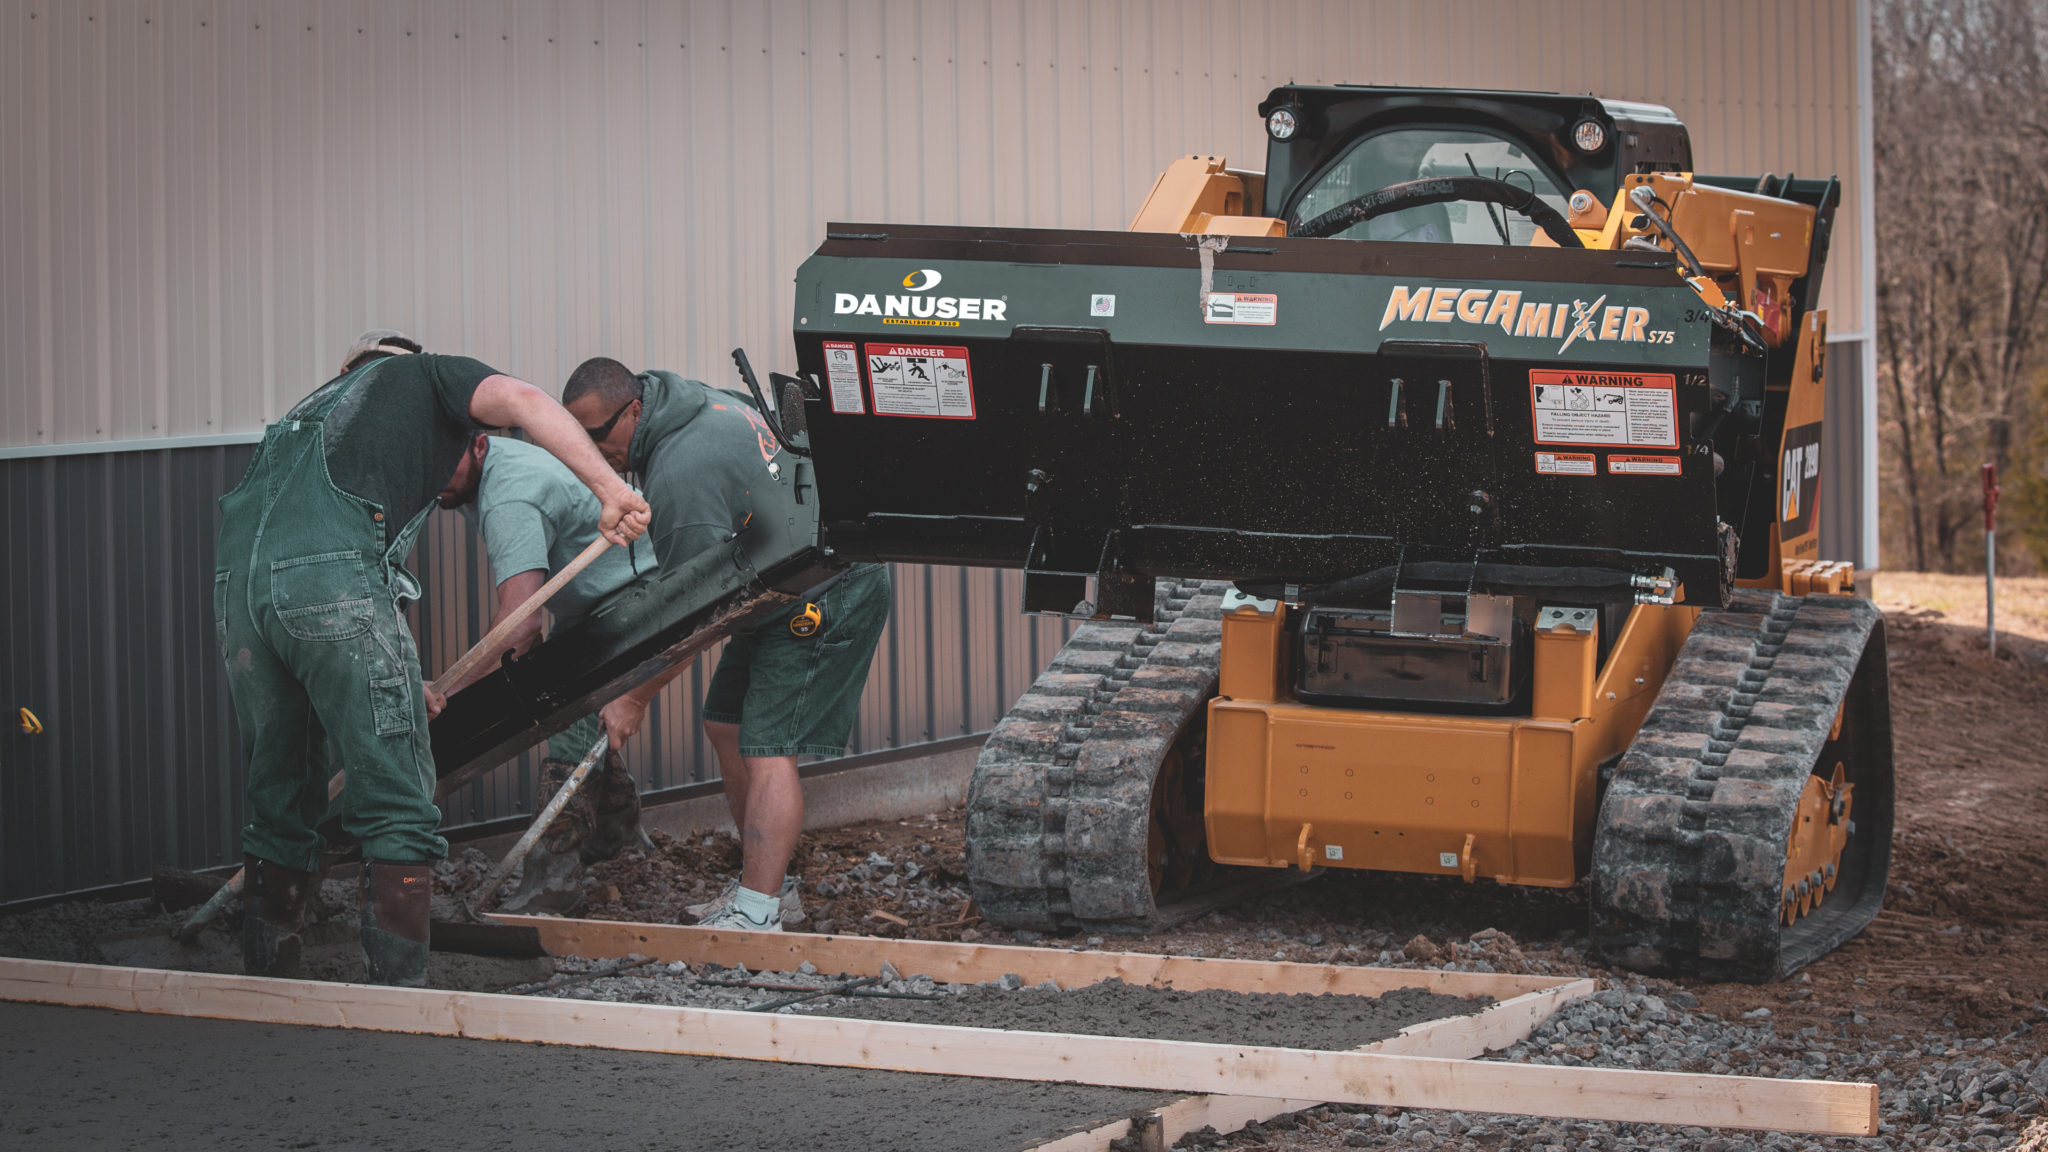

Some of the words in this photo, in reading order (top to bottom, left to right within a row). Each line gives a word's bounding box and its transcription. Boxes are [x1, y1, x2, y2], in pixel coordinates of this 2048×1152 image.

[834, 293, 1007, 321] DANUSER
[1648, 330, 1676, 344] S75
[897, 347, 945, 357] DANGER
[1576, 375, 1644, 387] WARNING
[1683, 373, 1707, 386] 1/2
[1783, 447, 1803, 522] CAT
